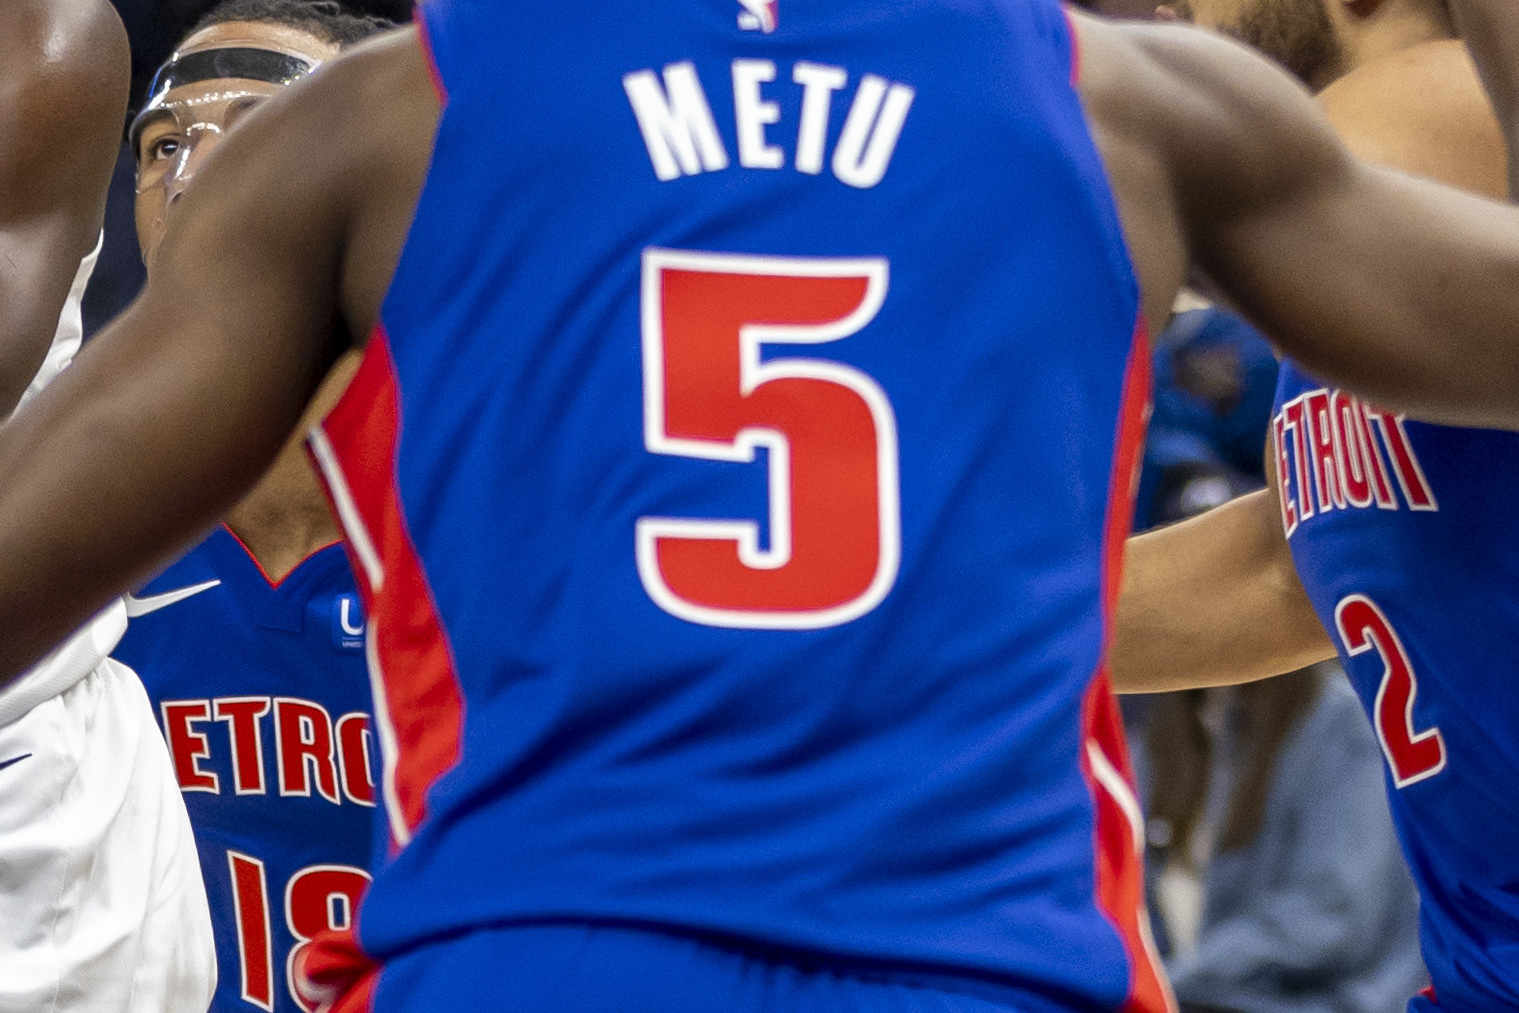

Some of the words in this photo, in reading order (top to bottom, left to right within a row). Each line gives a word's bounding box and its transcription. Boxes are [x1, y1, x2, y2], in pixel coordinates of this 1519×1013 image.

[622, 58, 916, 188] METU
[635, 247, 901, 630] 5
[1334, 593, 1447, 789] 2
